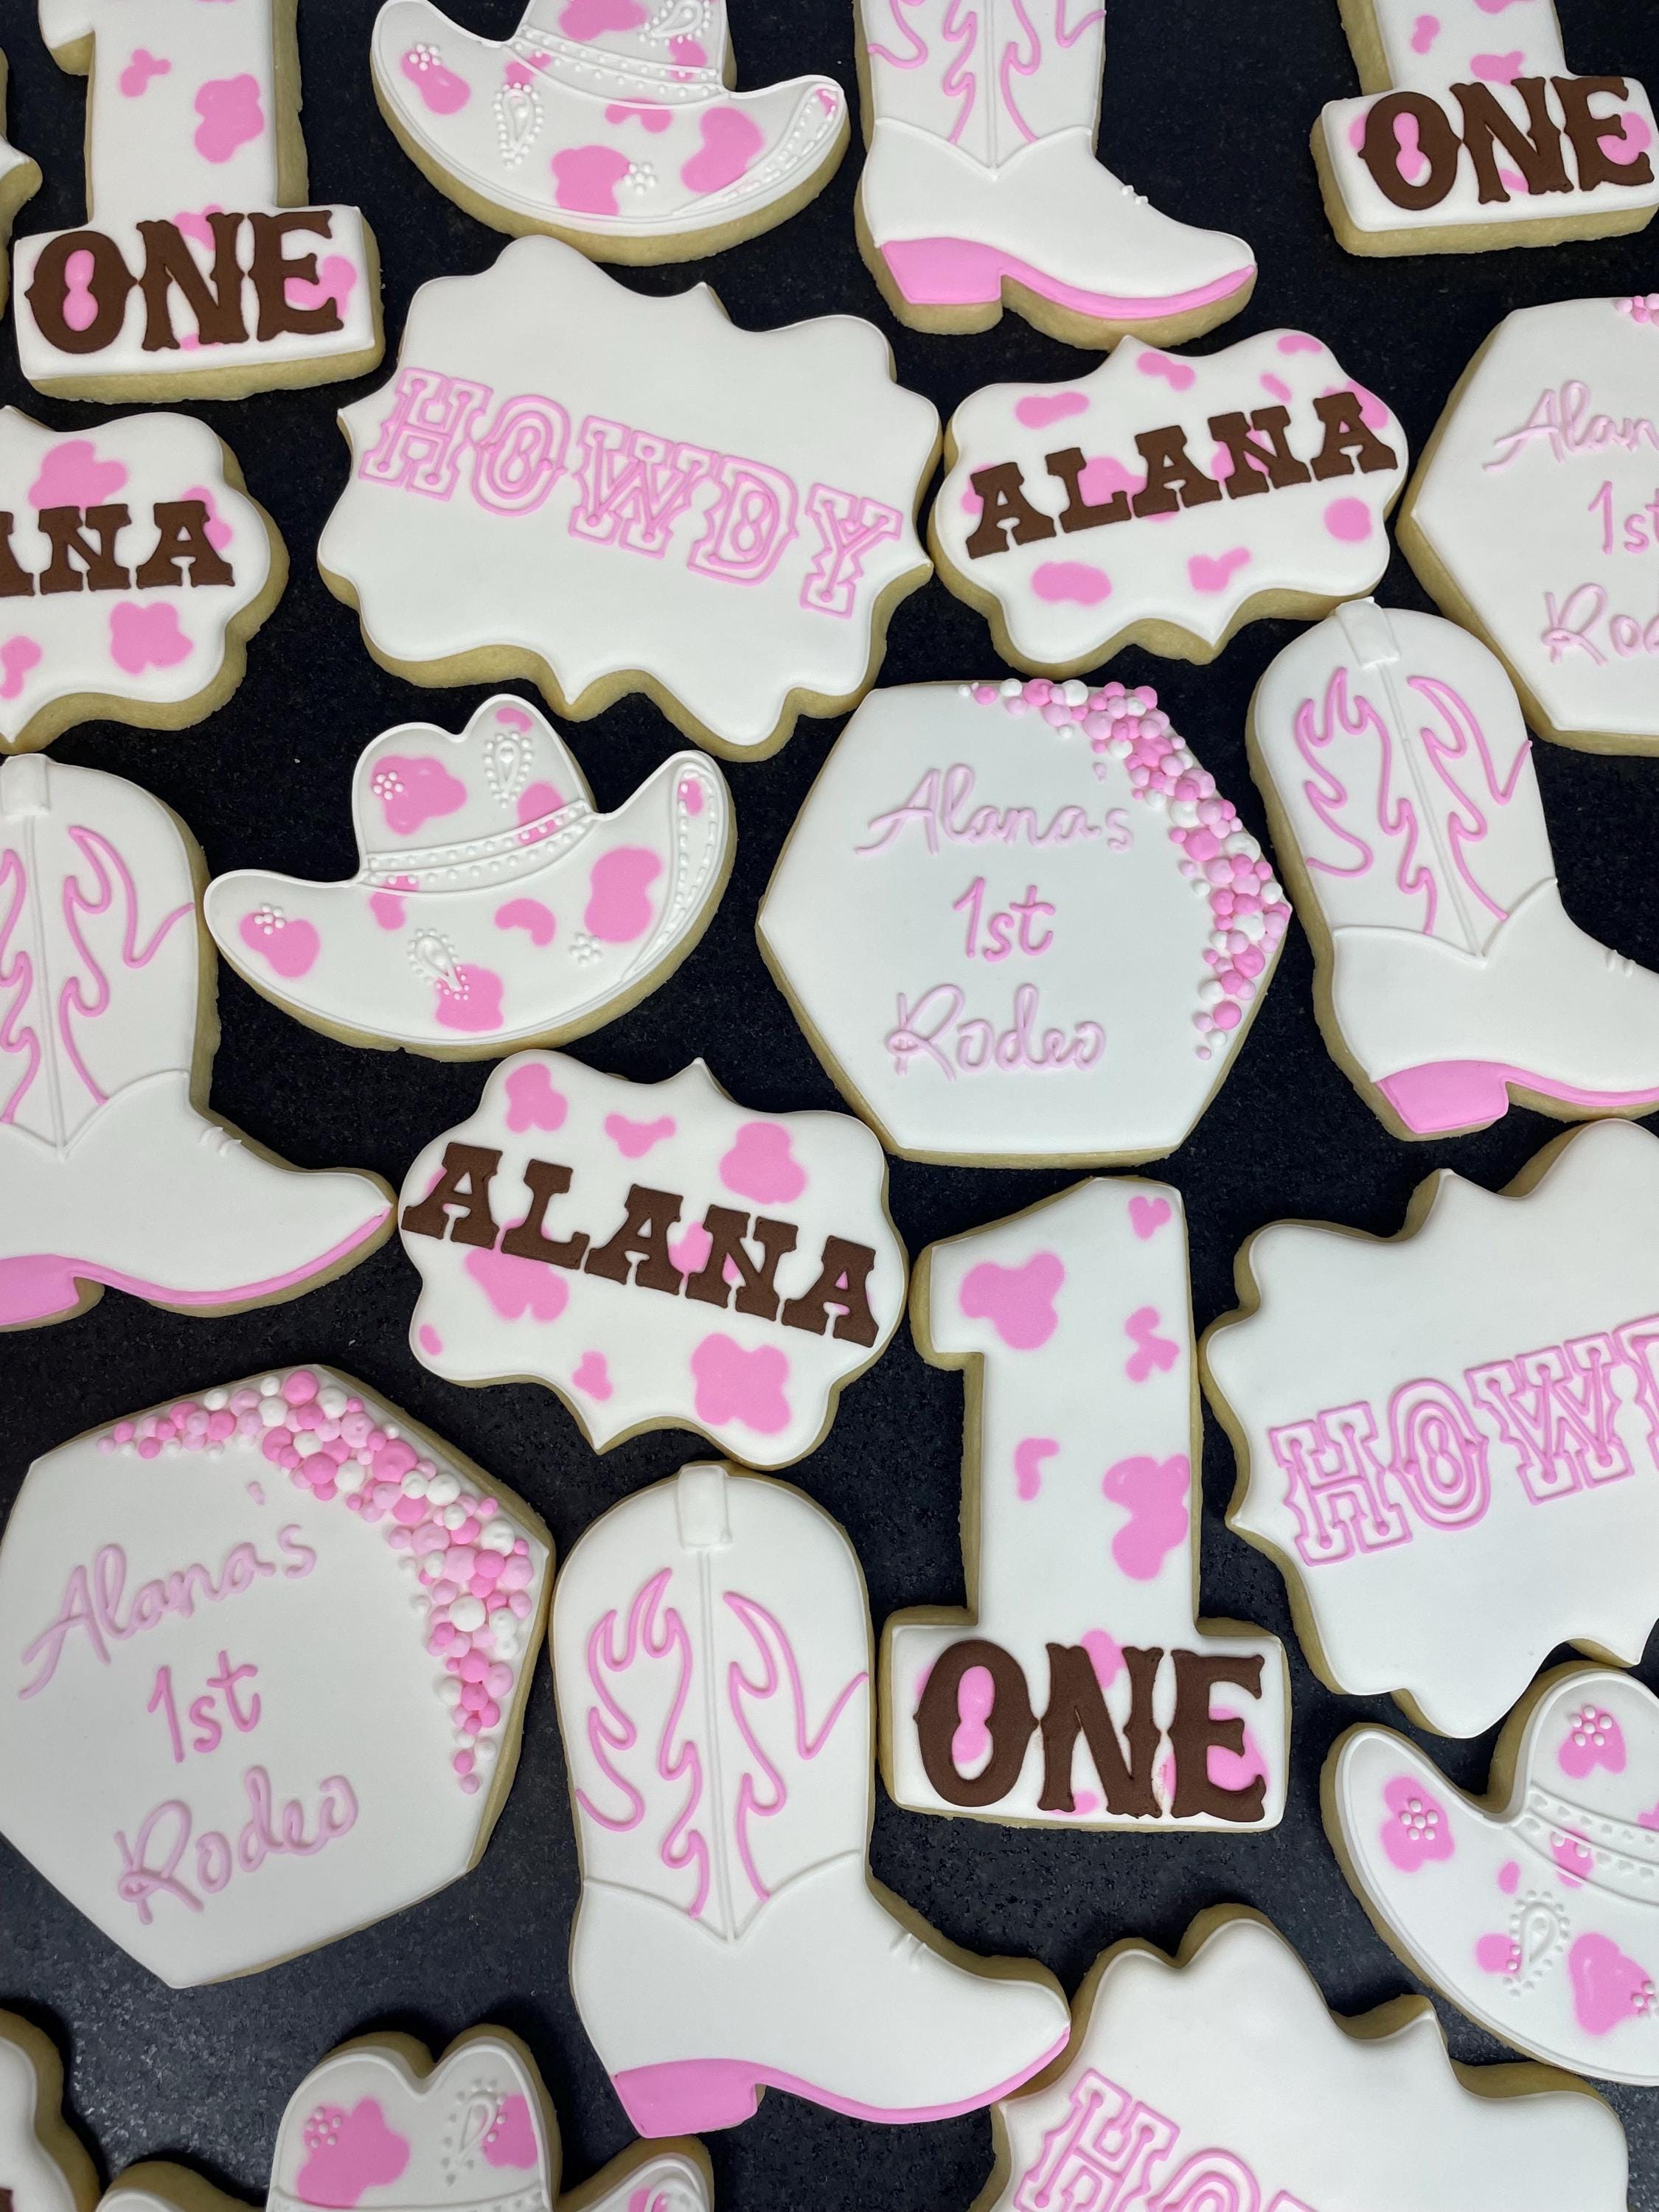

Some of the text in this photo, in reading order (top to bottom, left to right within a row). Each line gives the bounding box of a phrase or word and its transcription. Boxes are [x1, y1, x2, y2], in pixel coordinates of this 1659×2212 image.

[1358, 77, 1655, 210] ONE
[24, 210, 344, 354] ONE
[358, 368, 903, 619] HOWDY
[965, 392, 1399, 559] ALANA
[953, 876, 1055, 961] 1st
[885, 983, 1106, 1082] Rodeo
[401, 1141, 880, 1348] ALANA
[147, 1649, 261, 1763] 1st
[913, 1639, 1266, 1822] ONE
[118, 1765, 358, 1925] Rodeo
